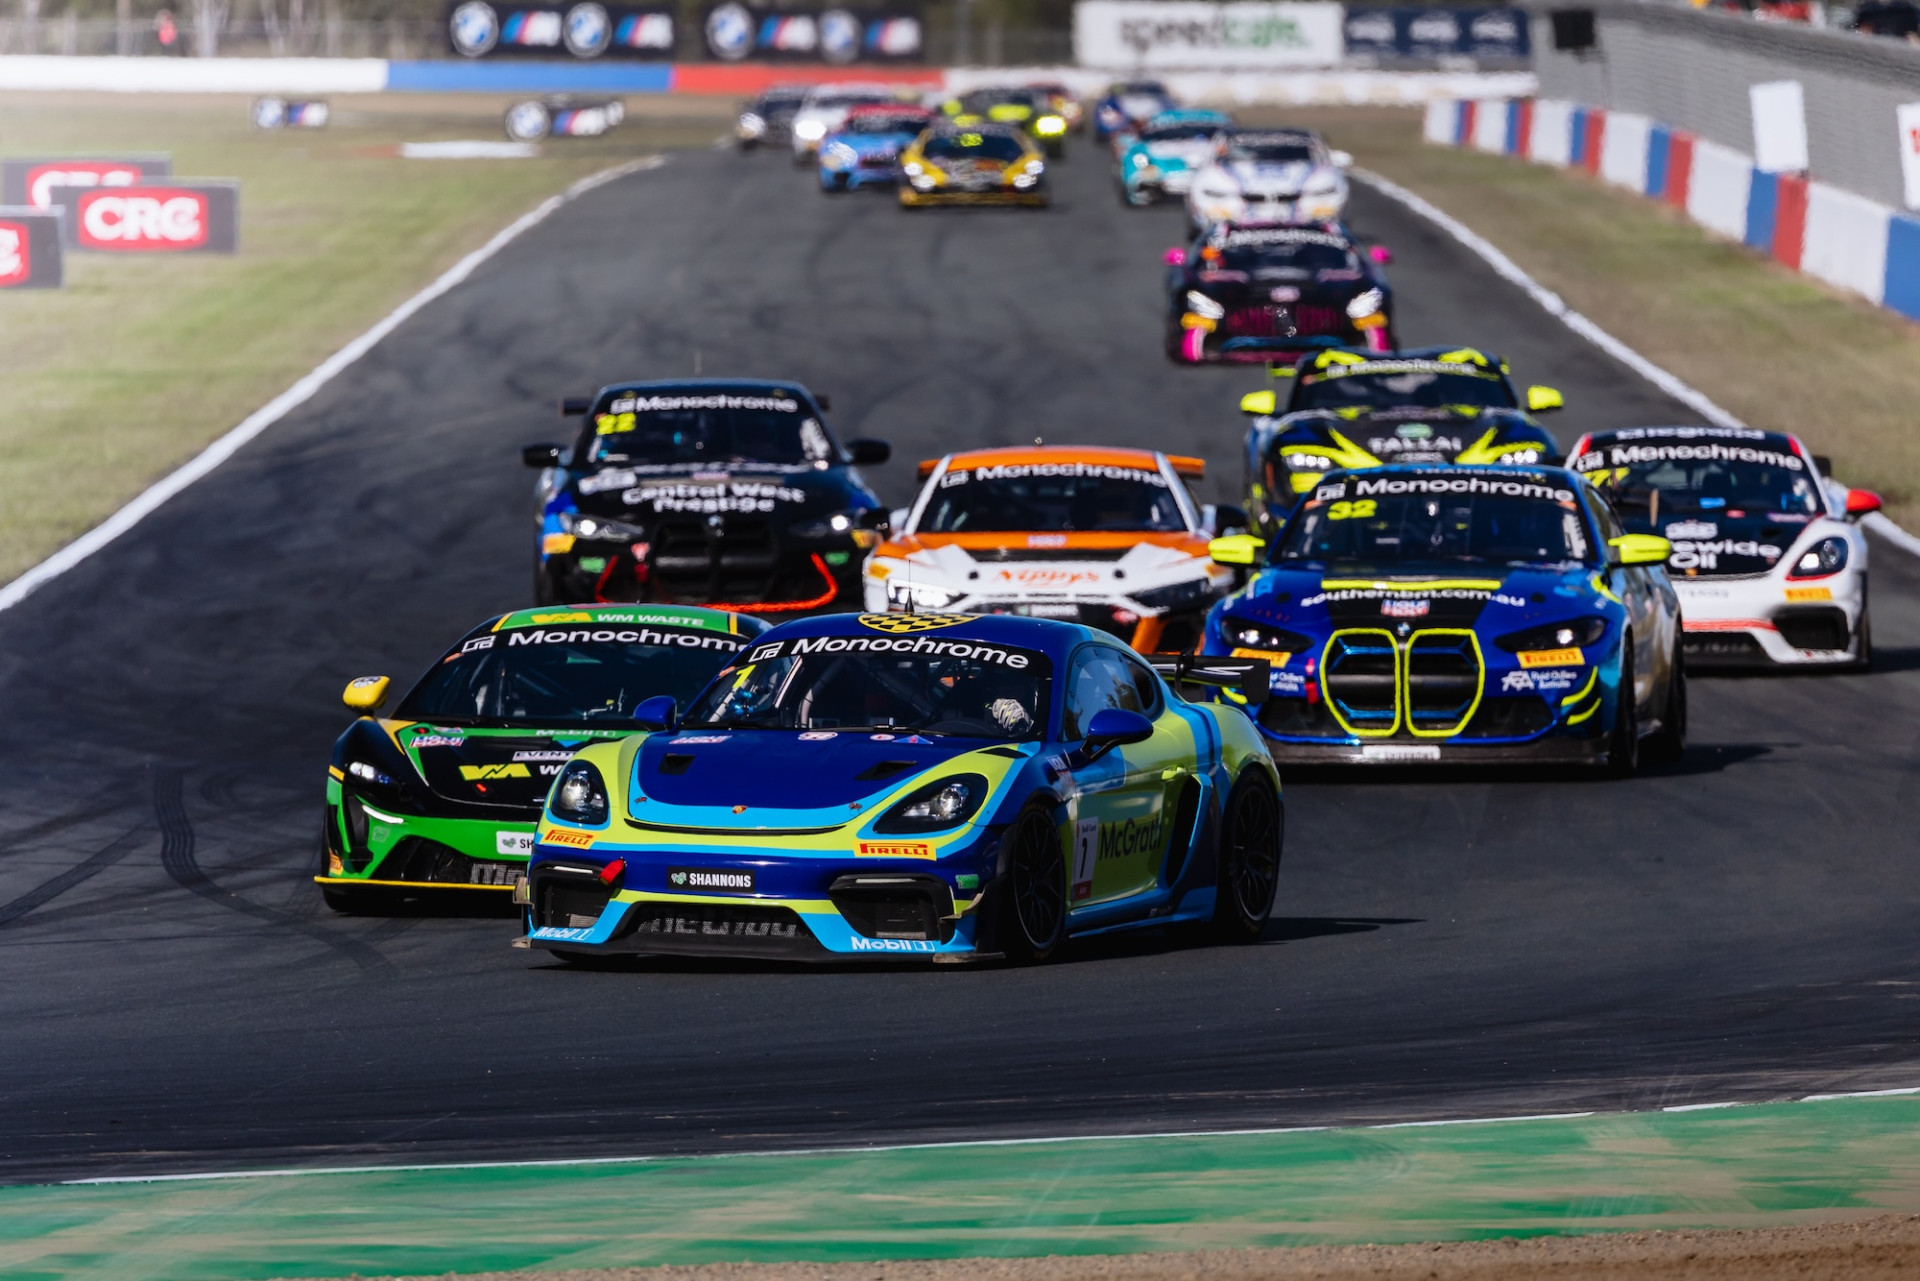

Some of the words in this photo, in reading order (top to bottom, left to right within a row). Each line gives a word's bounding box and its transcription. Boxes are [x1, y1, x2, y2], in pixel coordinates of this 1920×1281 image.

[84, 197, 200, 241] CRC
[635, 395, 799, 413] Monochrome
[1611, 443, 1803, 471] Monochrome
[976, 462, 1168, 488] Monochrome
[622, 483, 726, 504] Central
[731, 483, 805, 502] West
[1356, 478, 1574, 501] Monochrome
[1327, 500, 1378, 520] 32
[1670, 552, 1718, 569] Oil
[597, 614, 633, 623] WM
[638, 614, 705, 625] WASTE
[791, 637, 1029, 669] Monochrome
[732, 664, 757, 689] 1
[545, 829, 594, 846] PIRELLI
[1099, 813, 1162, 861] McGrath
[860, 842, 929, 855] PIRELLI
[688, 873, 752, 888] SHANNONS
[533, 927, 580, 938] Mobil
[851, 936, 912, 950] Mobil
